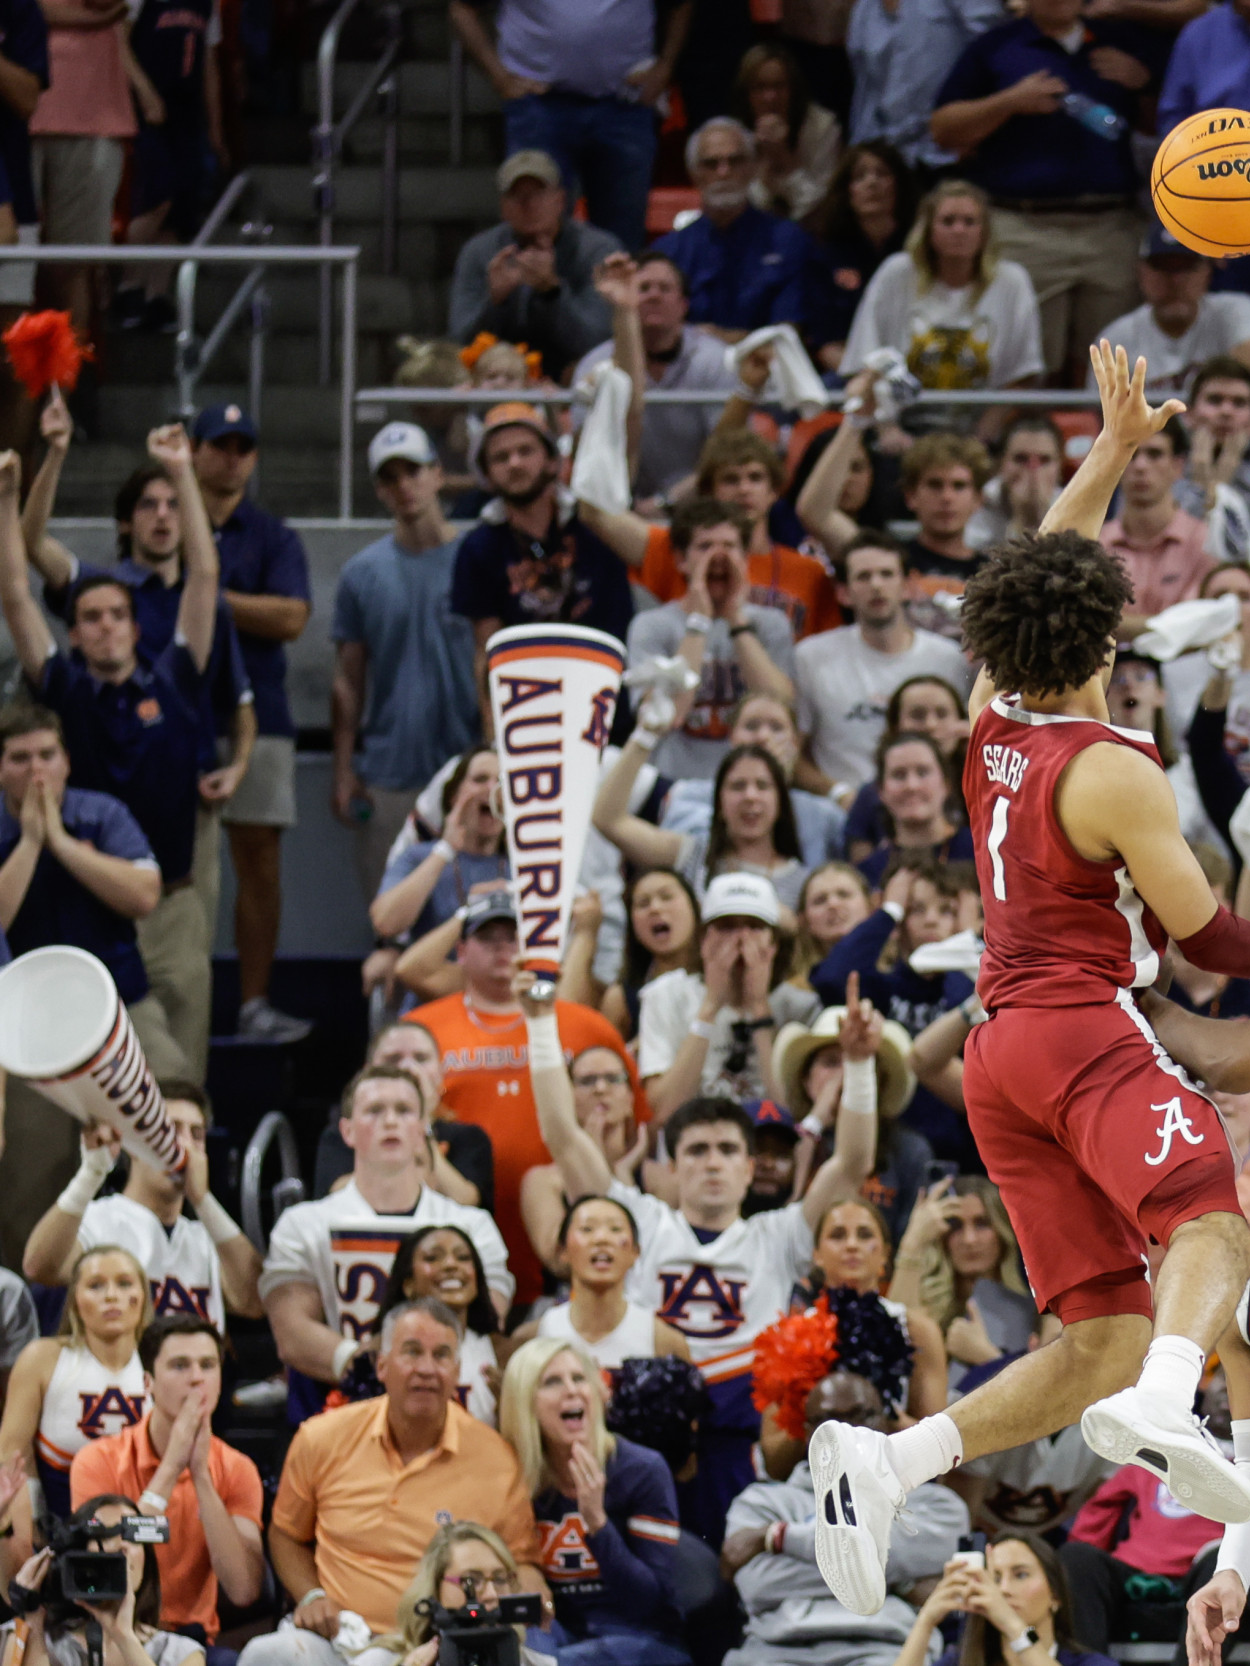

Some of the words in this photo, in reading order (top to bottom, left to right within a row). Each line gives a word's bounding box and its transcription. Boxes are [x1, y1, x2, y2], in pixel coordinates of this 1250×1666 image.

[498, 675, 563, 949] AUBURN
[983, 744, 1030, 793] SEARS
[987, 795, 1011, 901] 1
[1144, 1096, 1205, 1166] A
